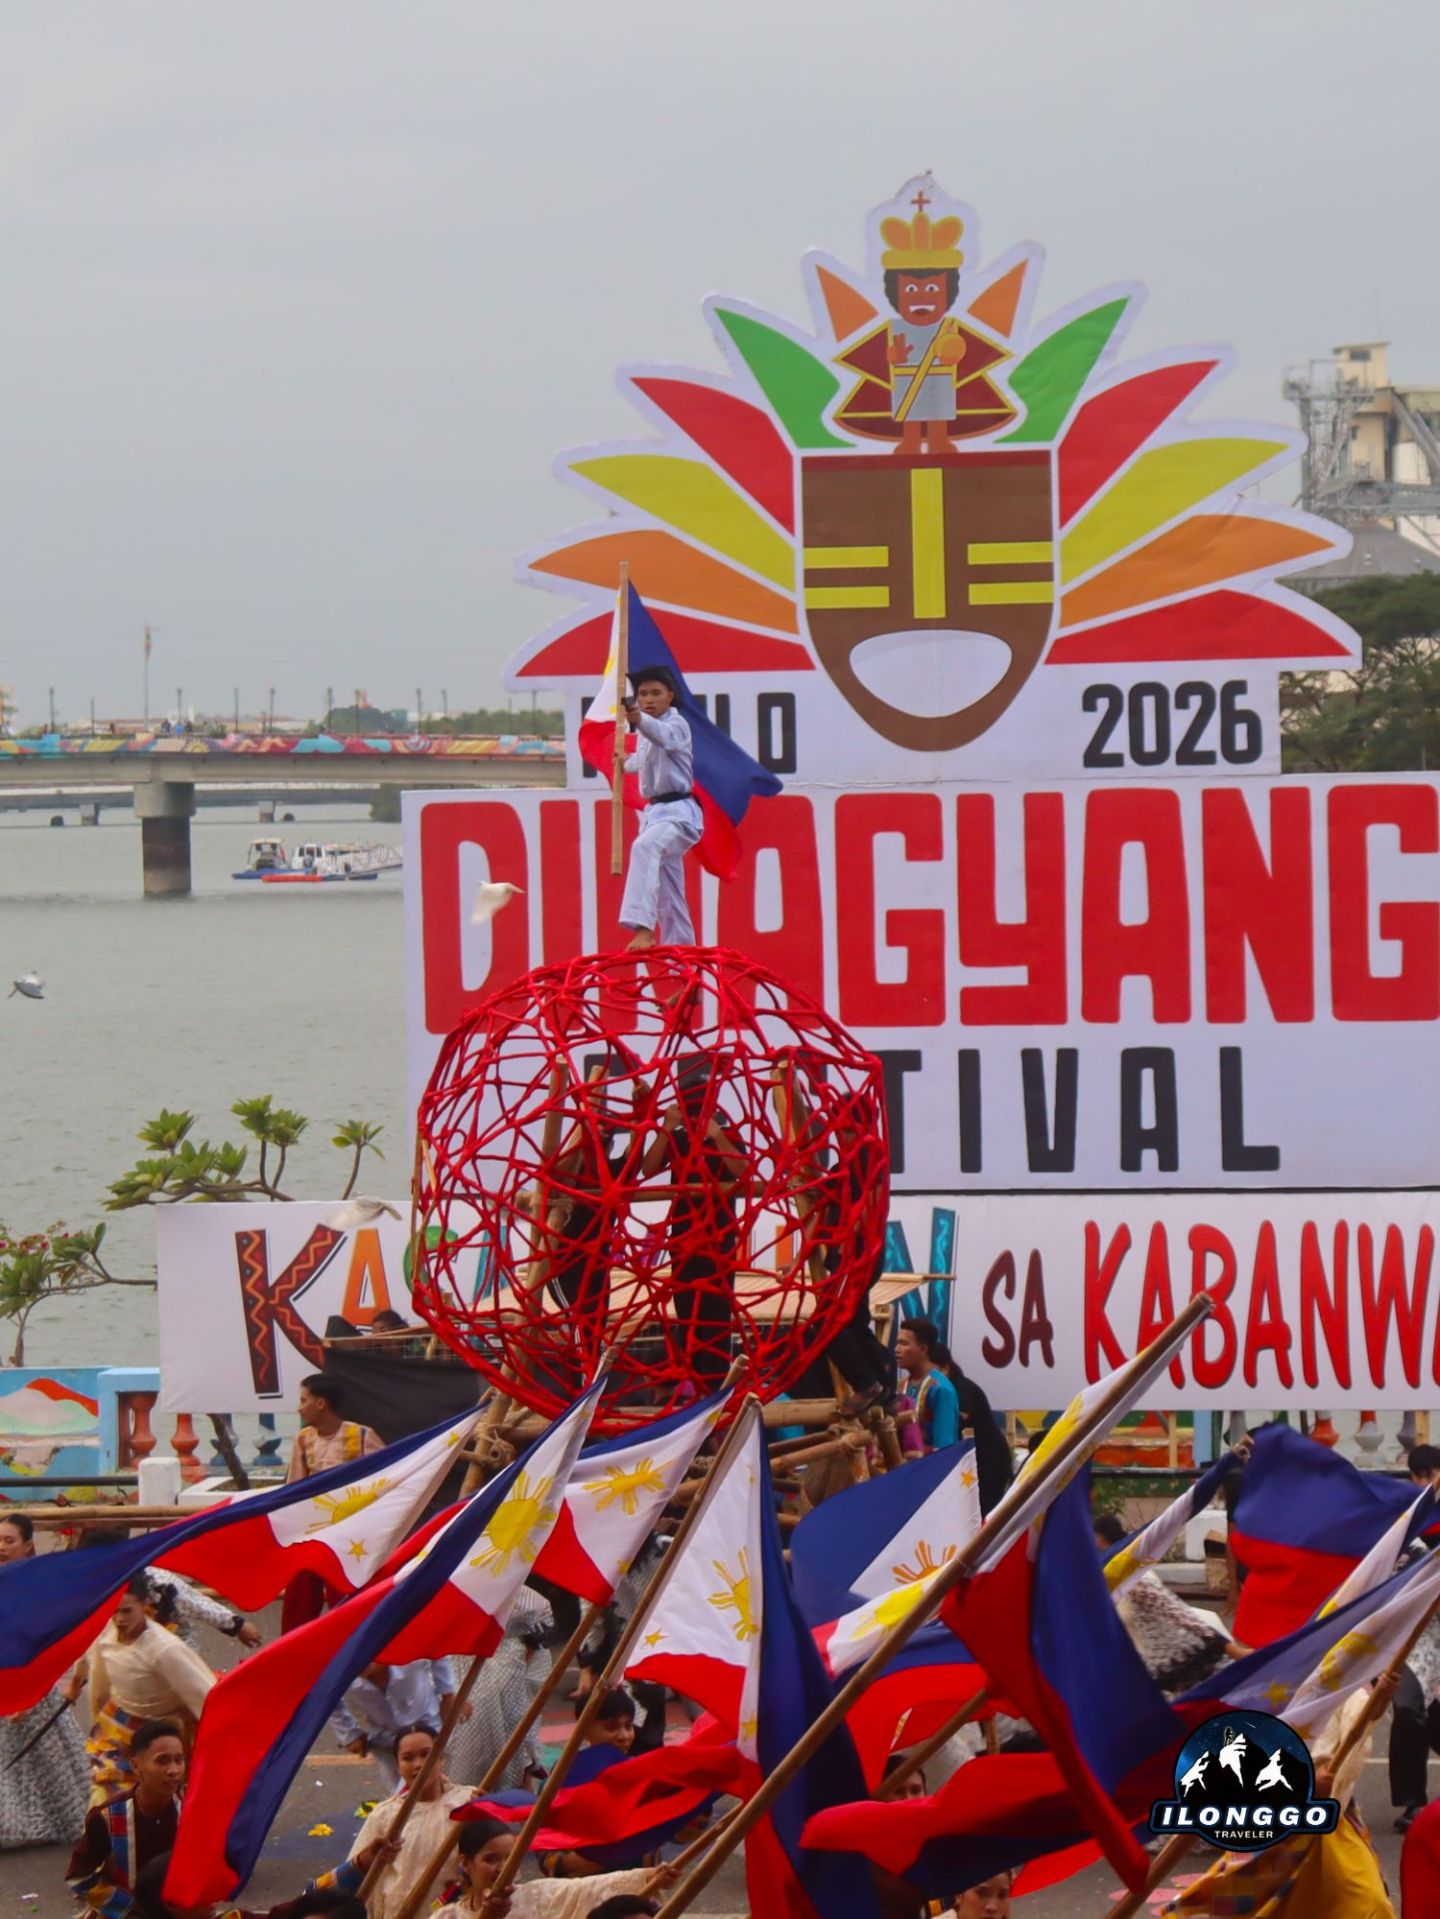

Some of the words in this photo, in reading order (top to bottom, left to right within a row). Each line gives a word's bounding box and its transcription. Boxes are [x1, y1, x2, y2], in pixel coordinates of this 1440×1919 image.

[1082, 679, 1263, 769] 2026
[583, 1046, 1280, 1175] TIVAL
[981, 1248, 1055, 1369] SA
